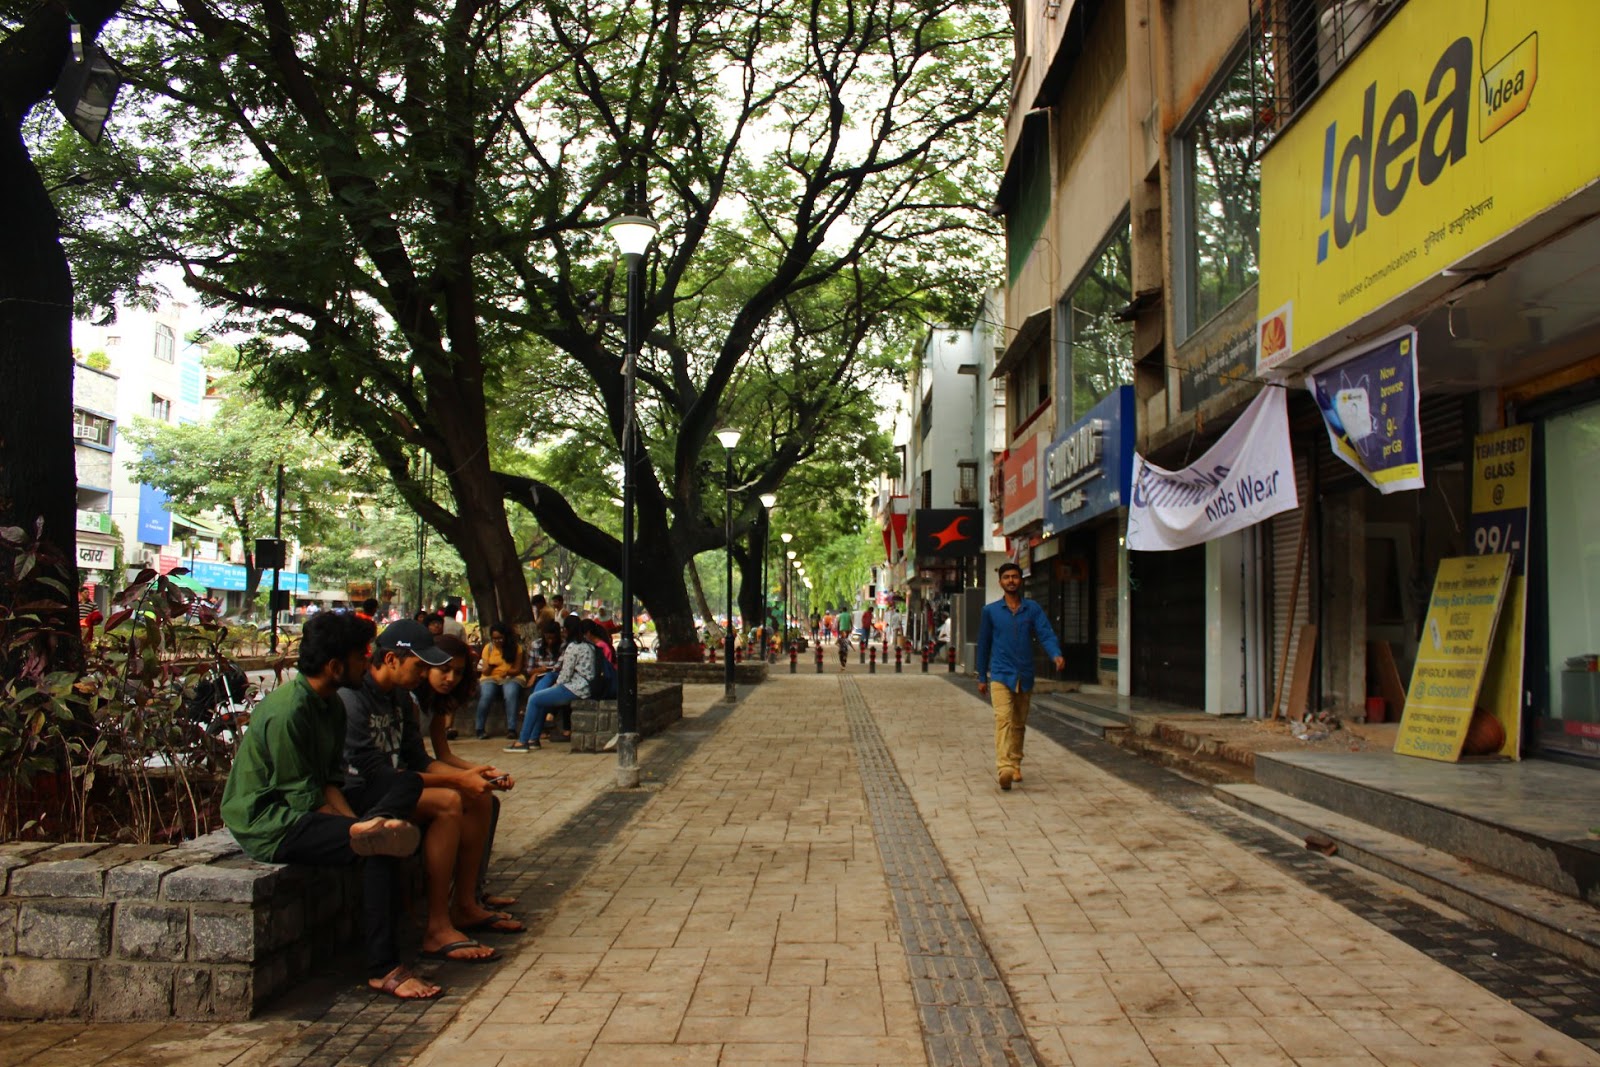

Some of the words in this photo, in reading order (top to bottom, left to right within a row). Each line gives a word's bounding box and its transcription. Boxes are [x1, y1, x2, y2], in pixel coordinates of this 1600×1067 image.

[1364, 247, 1418, 289] Communications
[1380, 366, 1396, 380] Now
[1380, 381, 1404, 399] browse
[1383, 443, 1392, 459] per
[1392, 439, 1403, 453] GB
[1475, 437, 1525, 460] TEMPERED
[1484, 461, 1515, 480] GLASS
[1236, 470, 1280, 509] Wear
[1493, 484, 1504, 505] @
[1475, 523, 1520, 555] 99/-
[1446, 629, 1474, 641] INTERNET
[1448, 668, 1477, 679] NUMBER
[1414, 681, 1425, 700] @
[1427, 684, 1471, 699] discount
[1413, 736, 1453, 756] Savings
